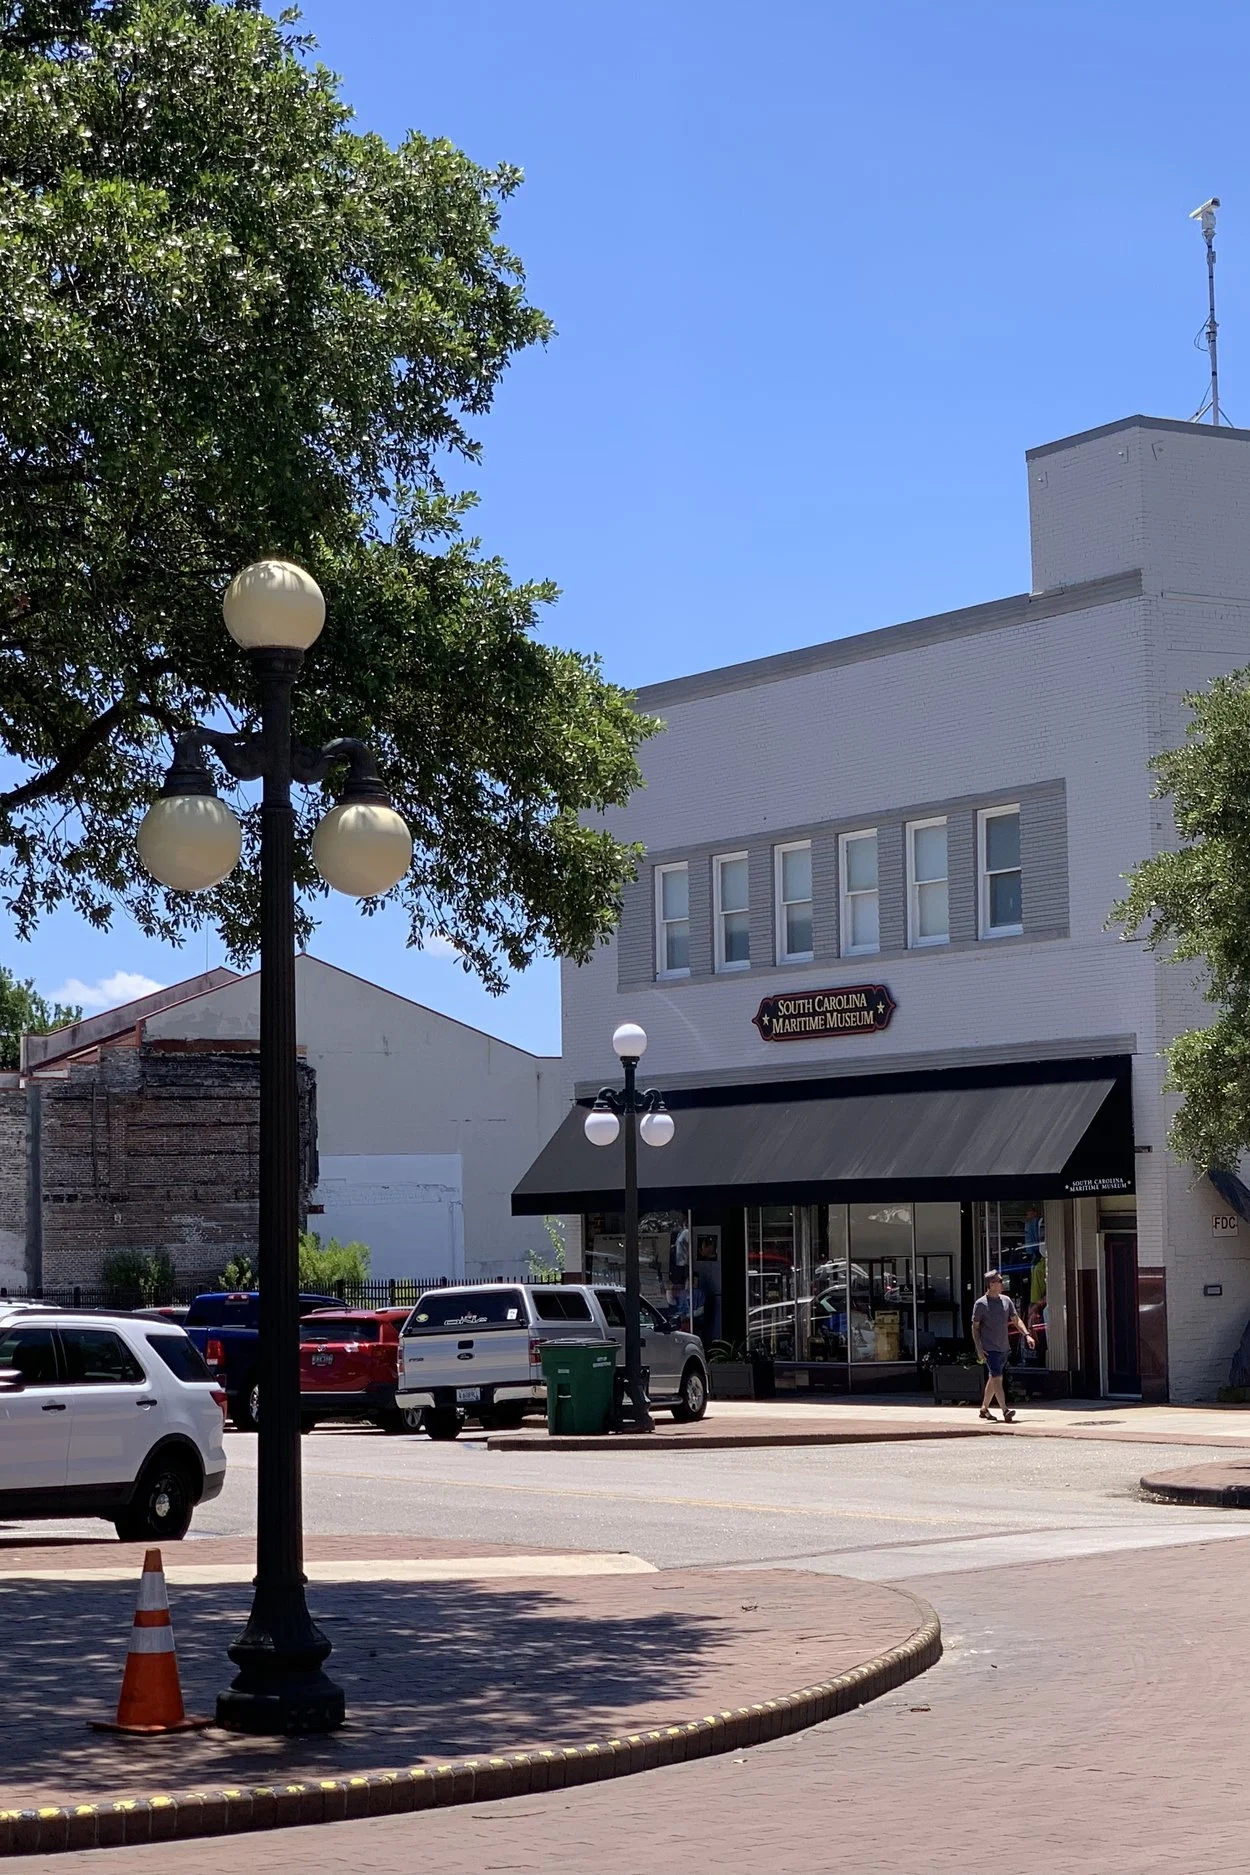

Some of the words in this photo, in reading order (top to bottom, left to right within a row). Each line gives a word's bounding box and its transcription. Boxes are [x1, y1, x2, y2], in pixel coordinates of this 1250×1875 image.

[777, 998, 813, 1016] SOUTH
[814, 993, 868, 1012] CAROLINA
[772, 1015, 825, 1034] MARITIME
[826, 1011, 874, 1029] MUSEUM
[1069, 1184, 1099, 1192] MARITIME
[1101, 1182, 1127, 1190] MUSEUM
[1072, 1179, 1093, 1187] SOUTH
[1093, 1177, 1123, 1185] CAROLINA
[1214, 1216, 1236, 1230] FDC
